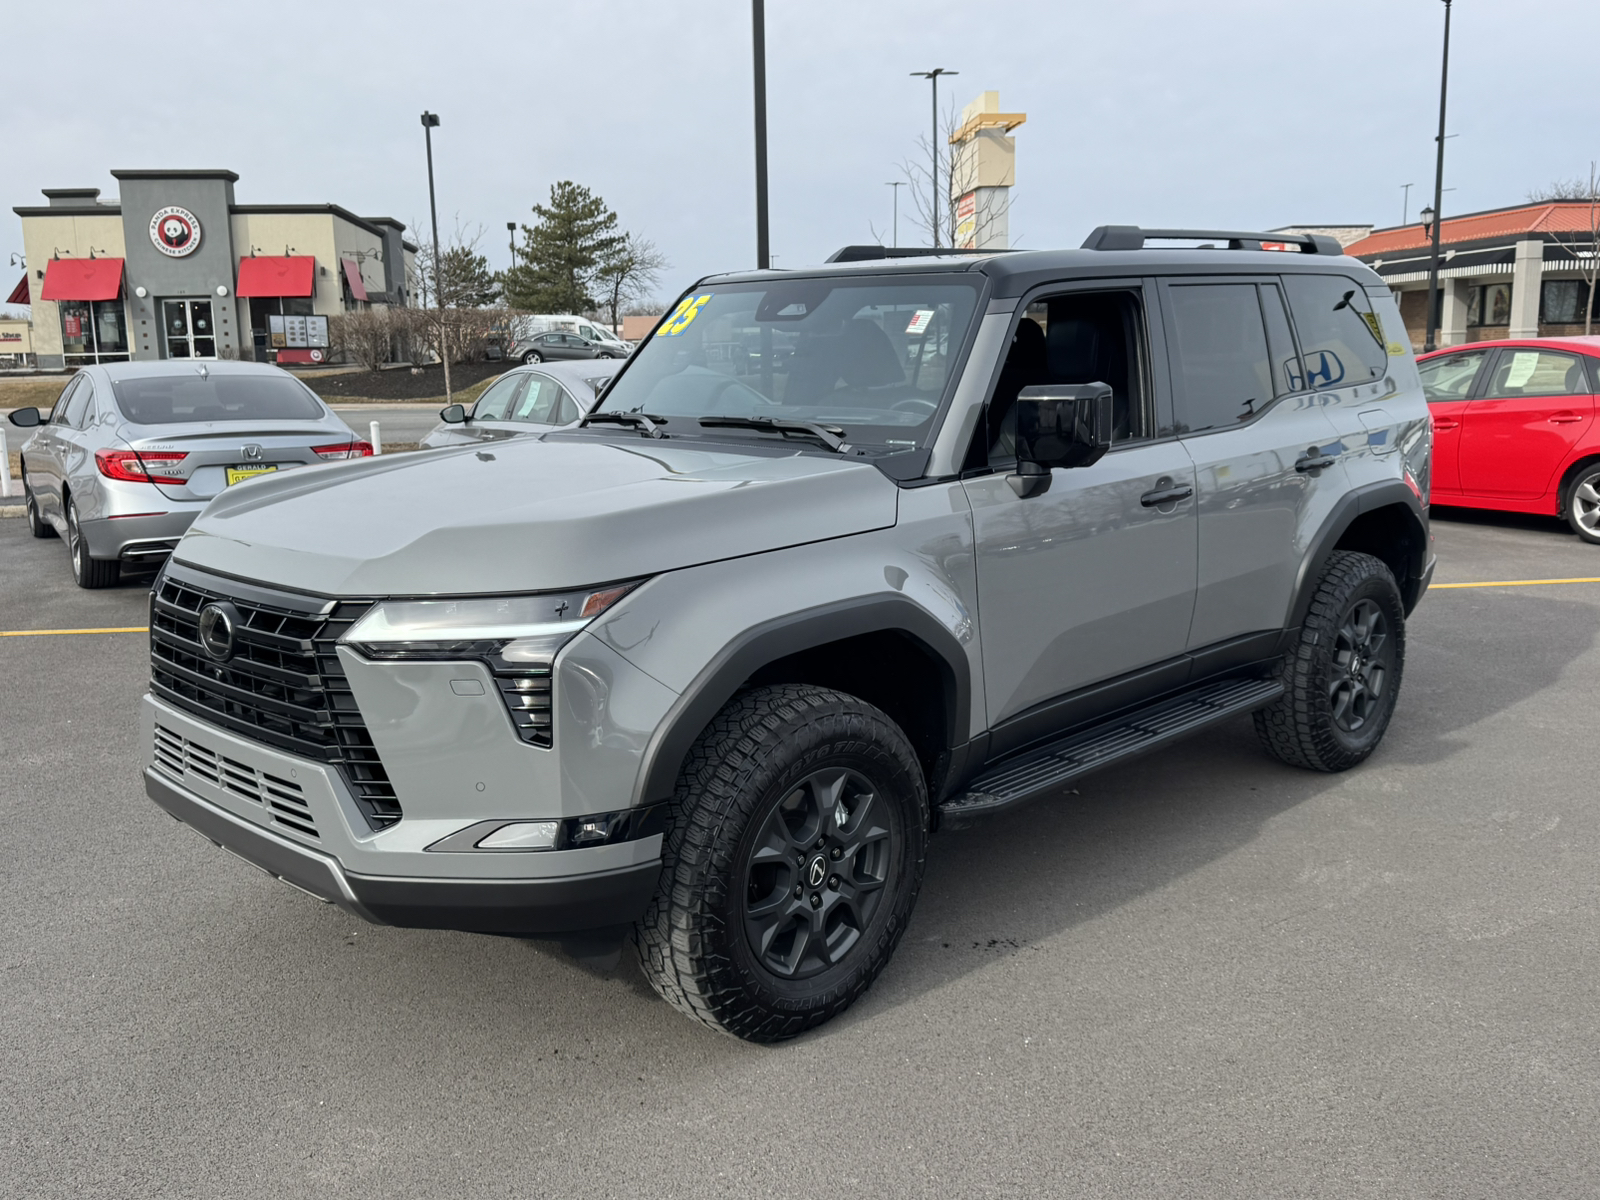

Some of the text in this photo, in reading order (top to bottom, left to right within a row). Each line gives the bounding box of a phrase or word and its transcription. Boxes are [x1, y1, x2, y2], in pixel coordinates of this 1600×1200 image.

[151, 208, 198, 229] PANDA EXPRESS
[656, 295, 711, 336] 25
[778, 743, 831, 787] TOYO
